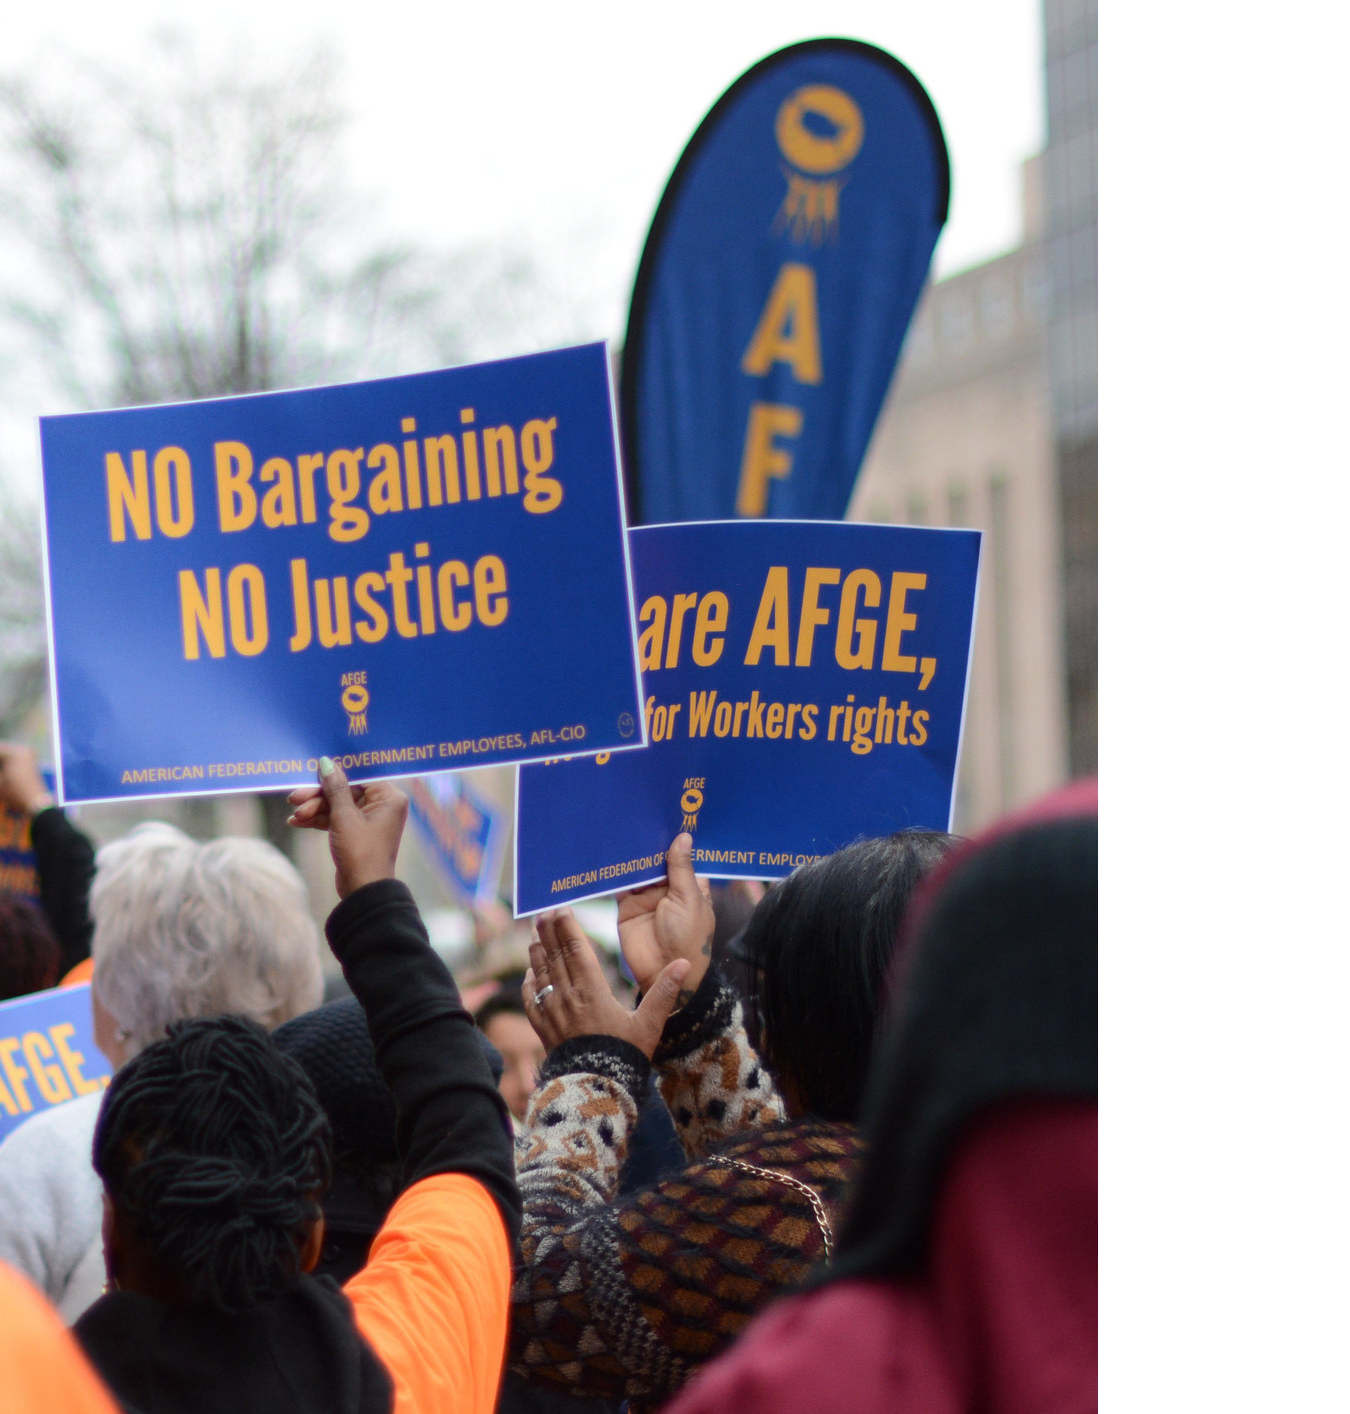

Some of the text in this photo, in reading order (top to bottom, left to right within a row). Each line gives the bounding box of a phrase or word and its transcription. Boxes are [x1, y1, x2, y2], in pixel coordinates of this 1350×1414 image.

[104, 408, 564, 543] NO Bargaining
[178, 542, 510, 660] NO Justice
[637, 566, 937, 691] are AFGE,
[341, 671, 368, 687] AFGE
[644, 690, 931, 755] for Workers rights
[121, 765, 204, 785] AMERICAN
[208, 759, 302, 778] FEDERATION
[334, 744, 435, 769] GOVERNMENT
[439, 733, 527, 757] EMPLOYEES,
[530, 725, 586, 745] AFL-CIO
[682, 777, 706, 789] AFGE
[550, 869, 598, 893] AMERICAN
[599, 857, 653, 880] FEDERATION
[653, 853, 665, 867] OF
